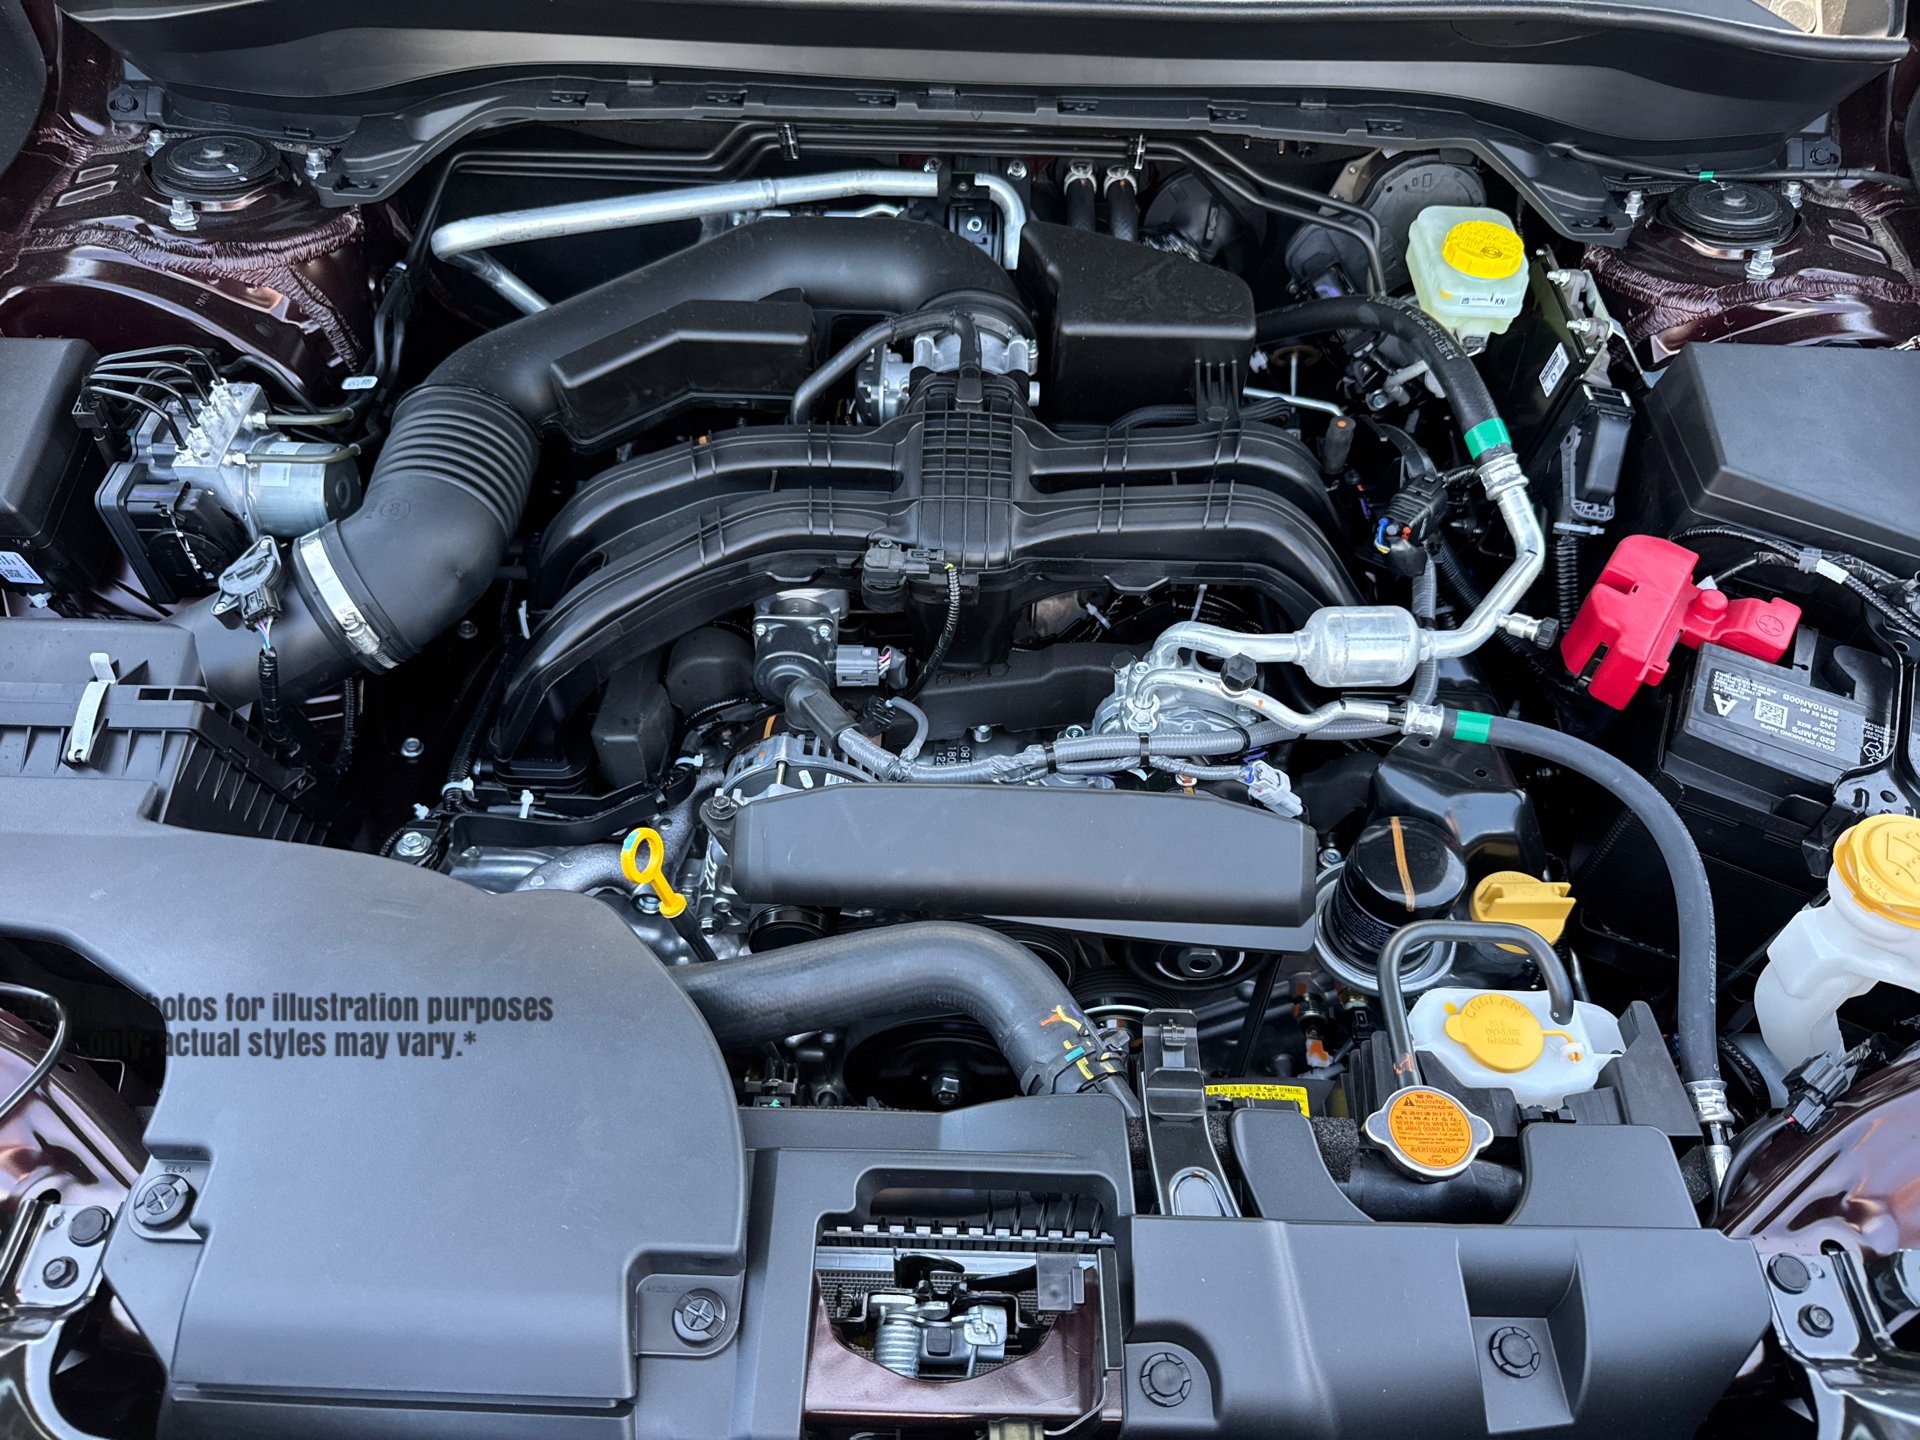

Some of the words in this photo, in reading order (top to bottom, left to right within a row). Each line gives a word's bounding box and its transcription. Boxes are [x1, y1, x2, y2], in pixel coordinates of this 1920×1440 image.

[1782, 693, 1839, 717] 82110AN00B
[1760, 723, 1779, 733] AMPS
[1819, 720, 1837, 732] LN2
[1779, 729, 1815, 746] CRANKING
[1791, 726, 1817, 740] AMPS
[1819, 735, 1836, 745] 620
[1815, 742, 1836, 752] COLD
[1862, 876, 1889, 901] PULL
[1360, 913, 1390, 933] CAUTION
[1465, 997, 1532, 1020] COOLANT
[1488, 1019, 1507, 1028] SEE
[1487, 1036, 1523, 1046] MANUAL
[164, 1165, 192, 1173] ELSA
